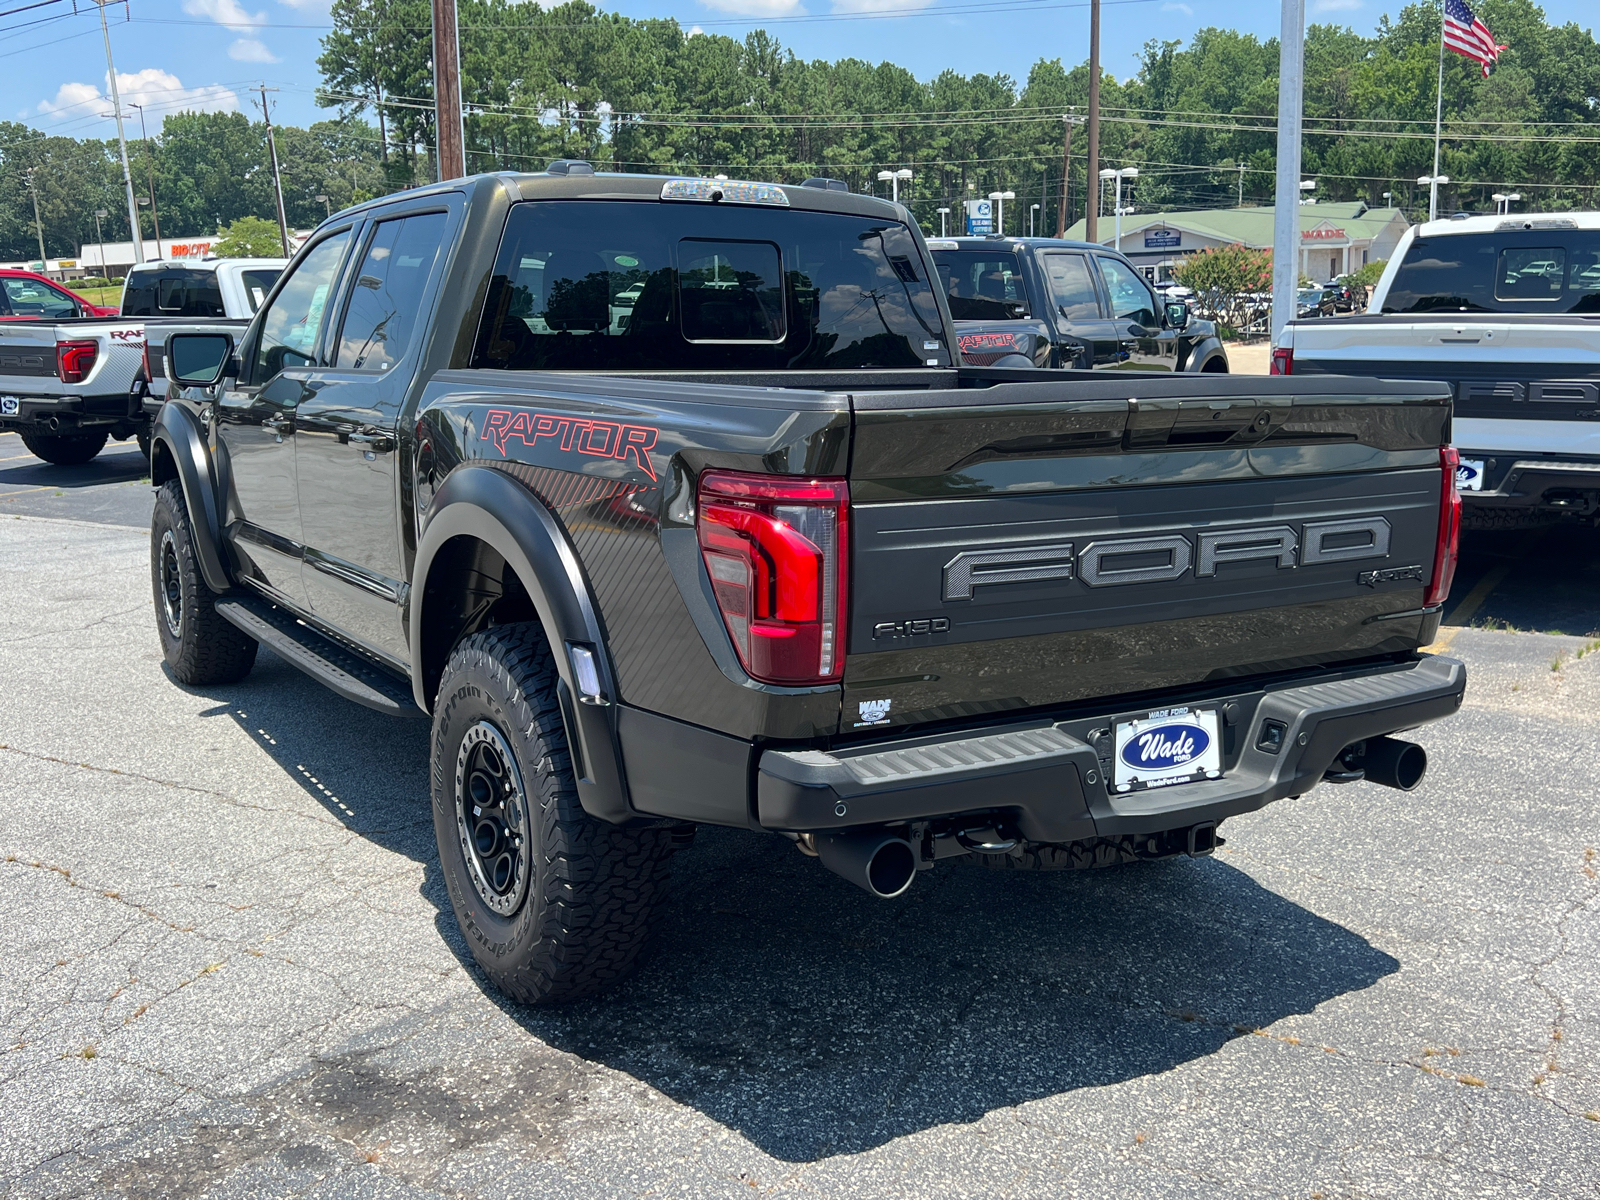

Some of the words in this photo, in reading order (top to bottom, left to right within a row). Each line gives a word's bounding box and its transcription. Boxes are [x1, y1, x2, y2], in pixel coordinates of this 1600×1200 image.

[1301, 229, 1345, 239] WADE
[171, 244, 189, 256] BIG
[480, 409, 660, 482] RAPTOR
[941, 515, 1392, 601] FORD
[1357, 564, 1423, 589] RAPTOR
[872, 616, 951, 640] F-150
[859, 698, 891, 715] WADE
[1148, 709, 1170, 719] WADE
[1170, 706, 1189, 716] FORD
[1138, 730, 1195, 762] Wade
[1173, 753, 1191, 762] FORD
[1146, 775, 1190, 788] WadeFord.com
